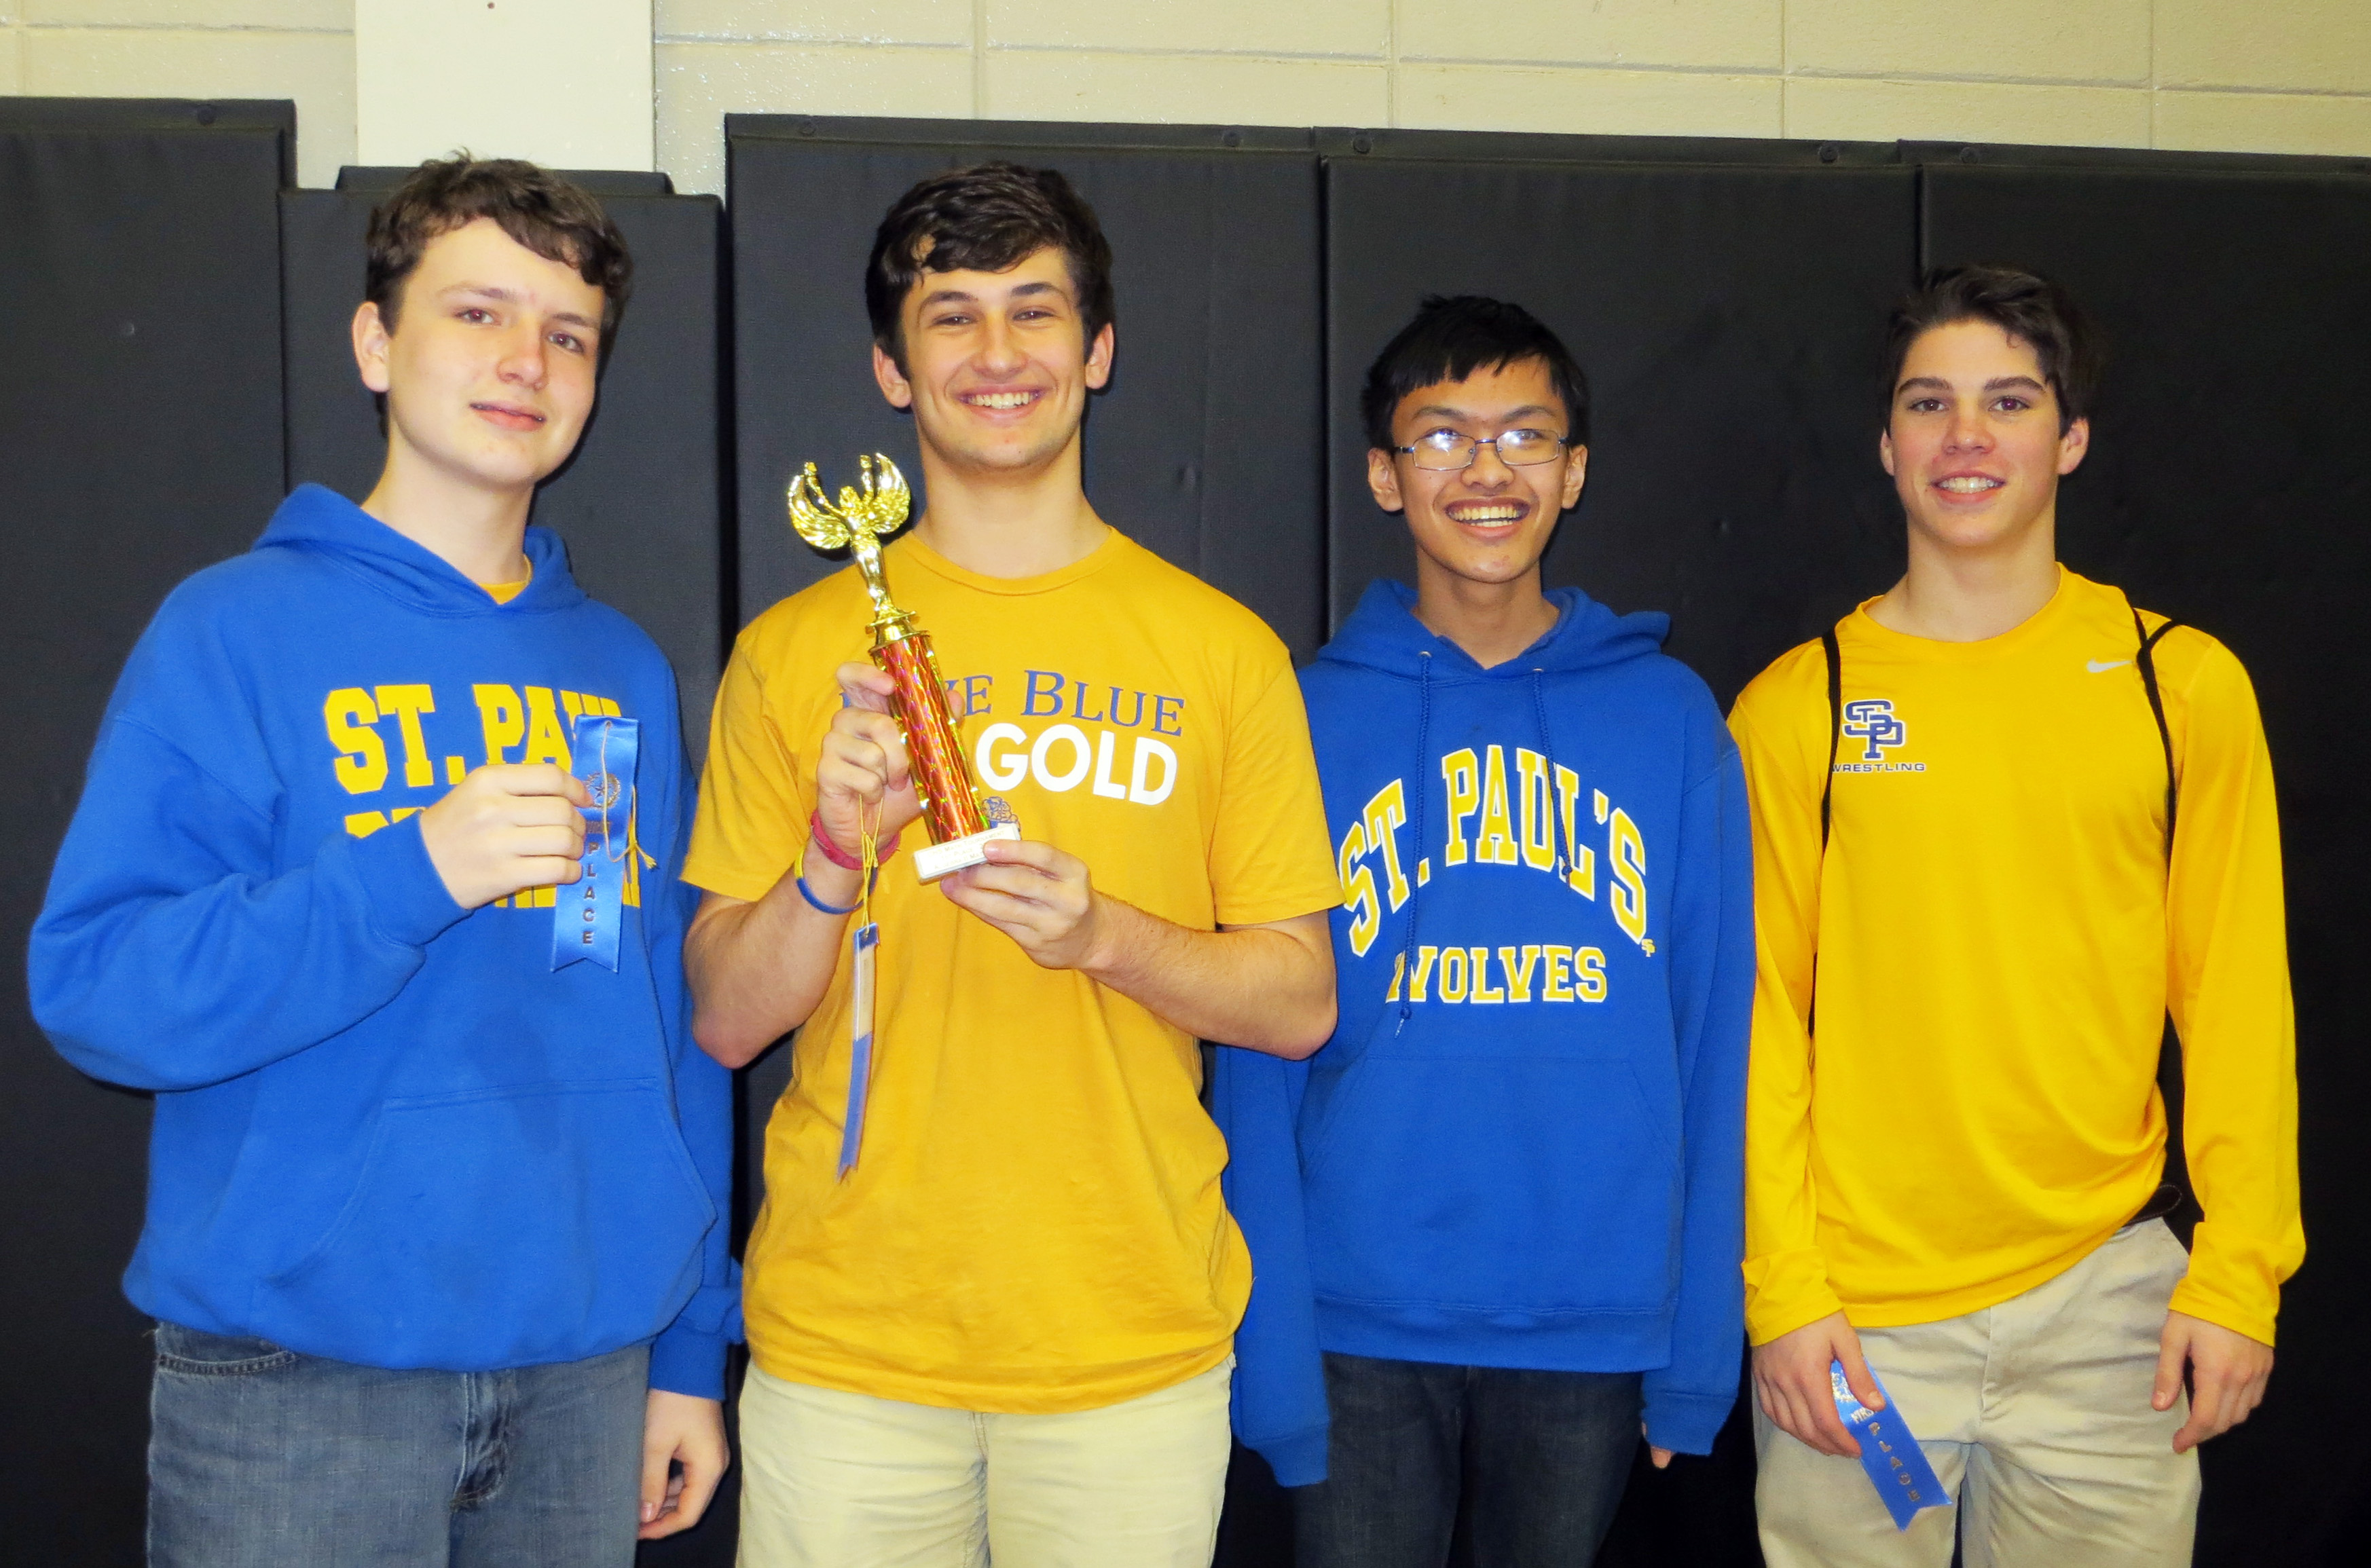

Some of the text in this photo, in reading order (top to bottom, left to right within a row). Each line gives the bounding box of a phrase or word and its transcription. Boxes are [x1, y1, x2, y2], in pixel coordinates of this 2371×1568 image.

[324, 684, 466, 795] ST.
[1021, 670, 1184, 736] BLUE
[976, 723, 1178, 806] GOLD
[1831, 763, 1926, 772] WRESTLING
[1338, 745, 1647, 957] ST. PAUL'S
[582, 842, 600, 944] PLACE
[1385, 945, 1607, 1004] WOLVES
